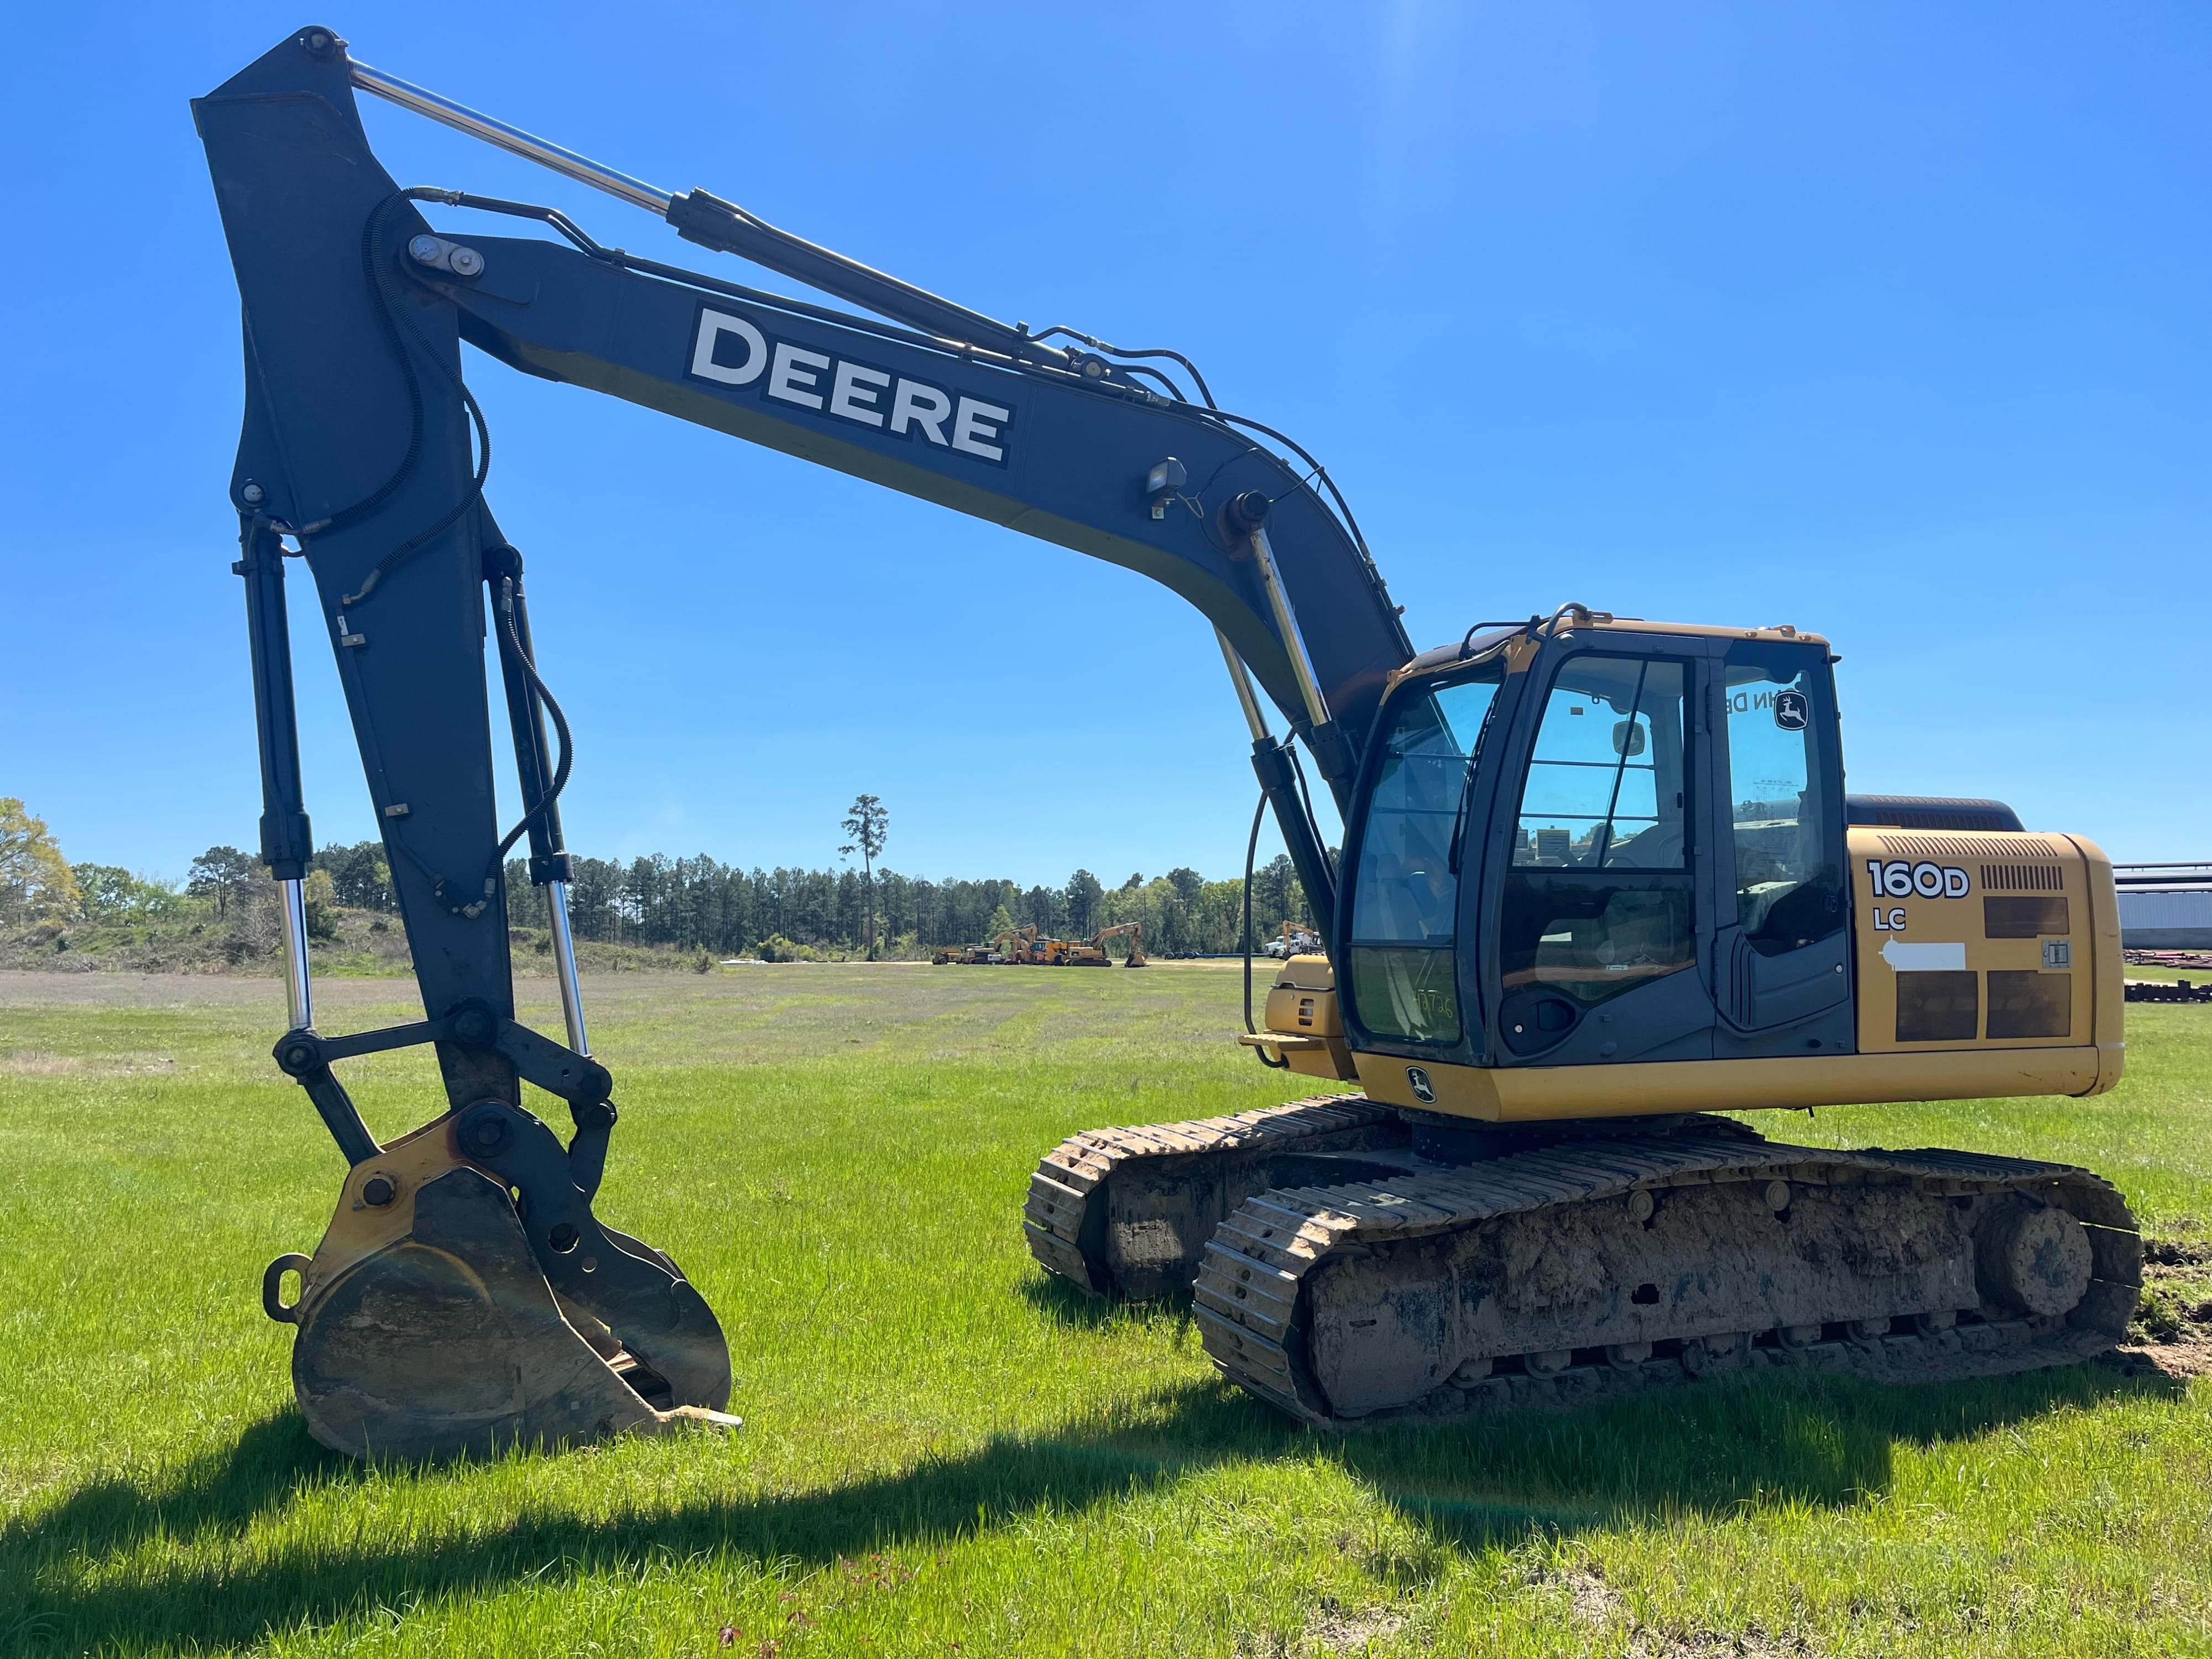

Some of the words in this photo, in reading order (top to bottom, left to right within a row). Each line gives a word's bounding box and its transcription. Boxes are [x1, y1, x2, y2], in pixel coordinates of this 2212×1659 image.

[691, 307, 1009, 461] DEERE
[1868, 861, 1969, 898] 160D
[1874, 908, 1906, 930] LC
